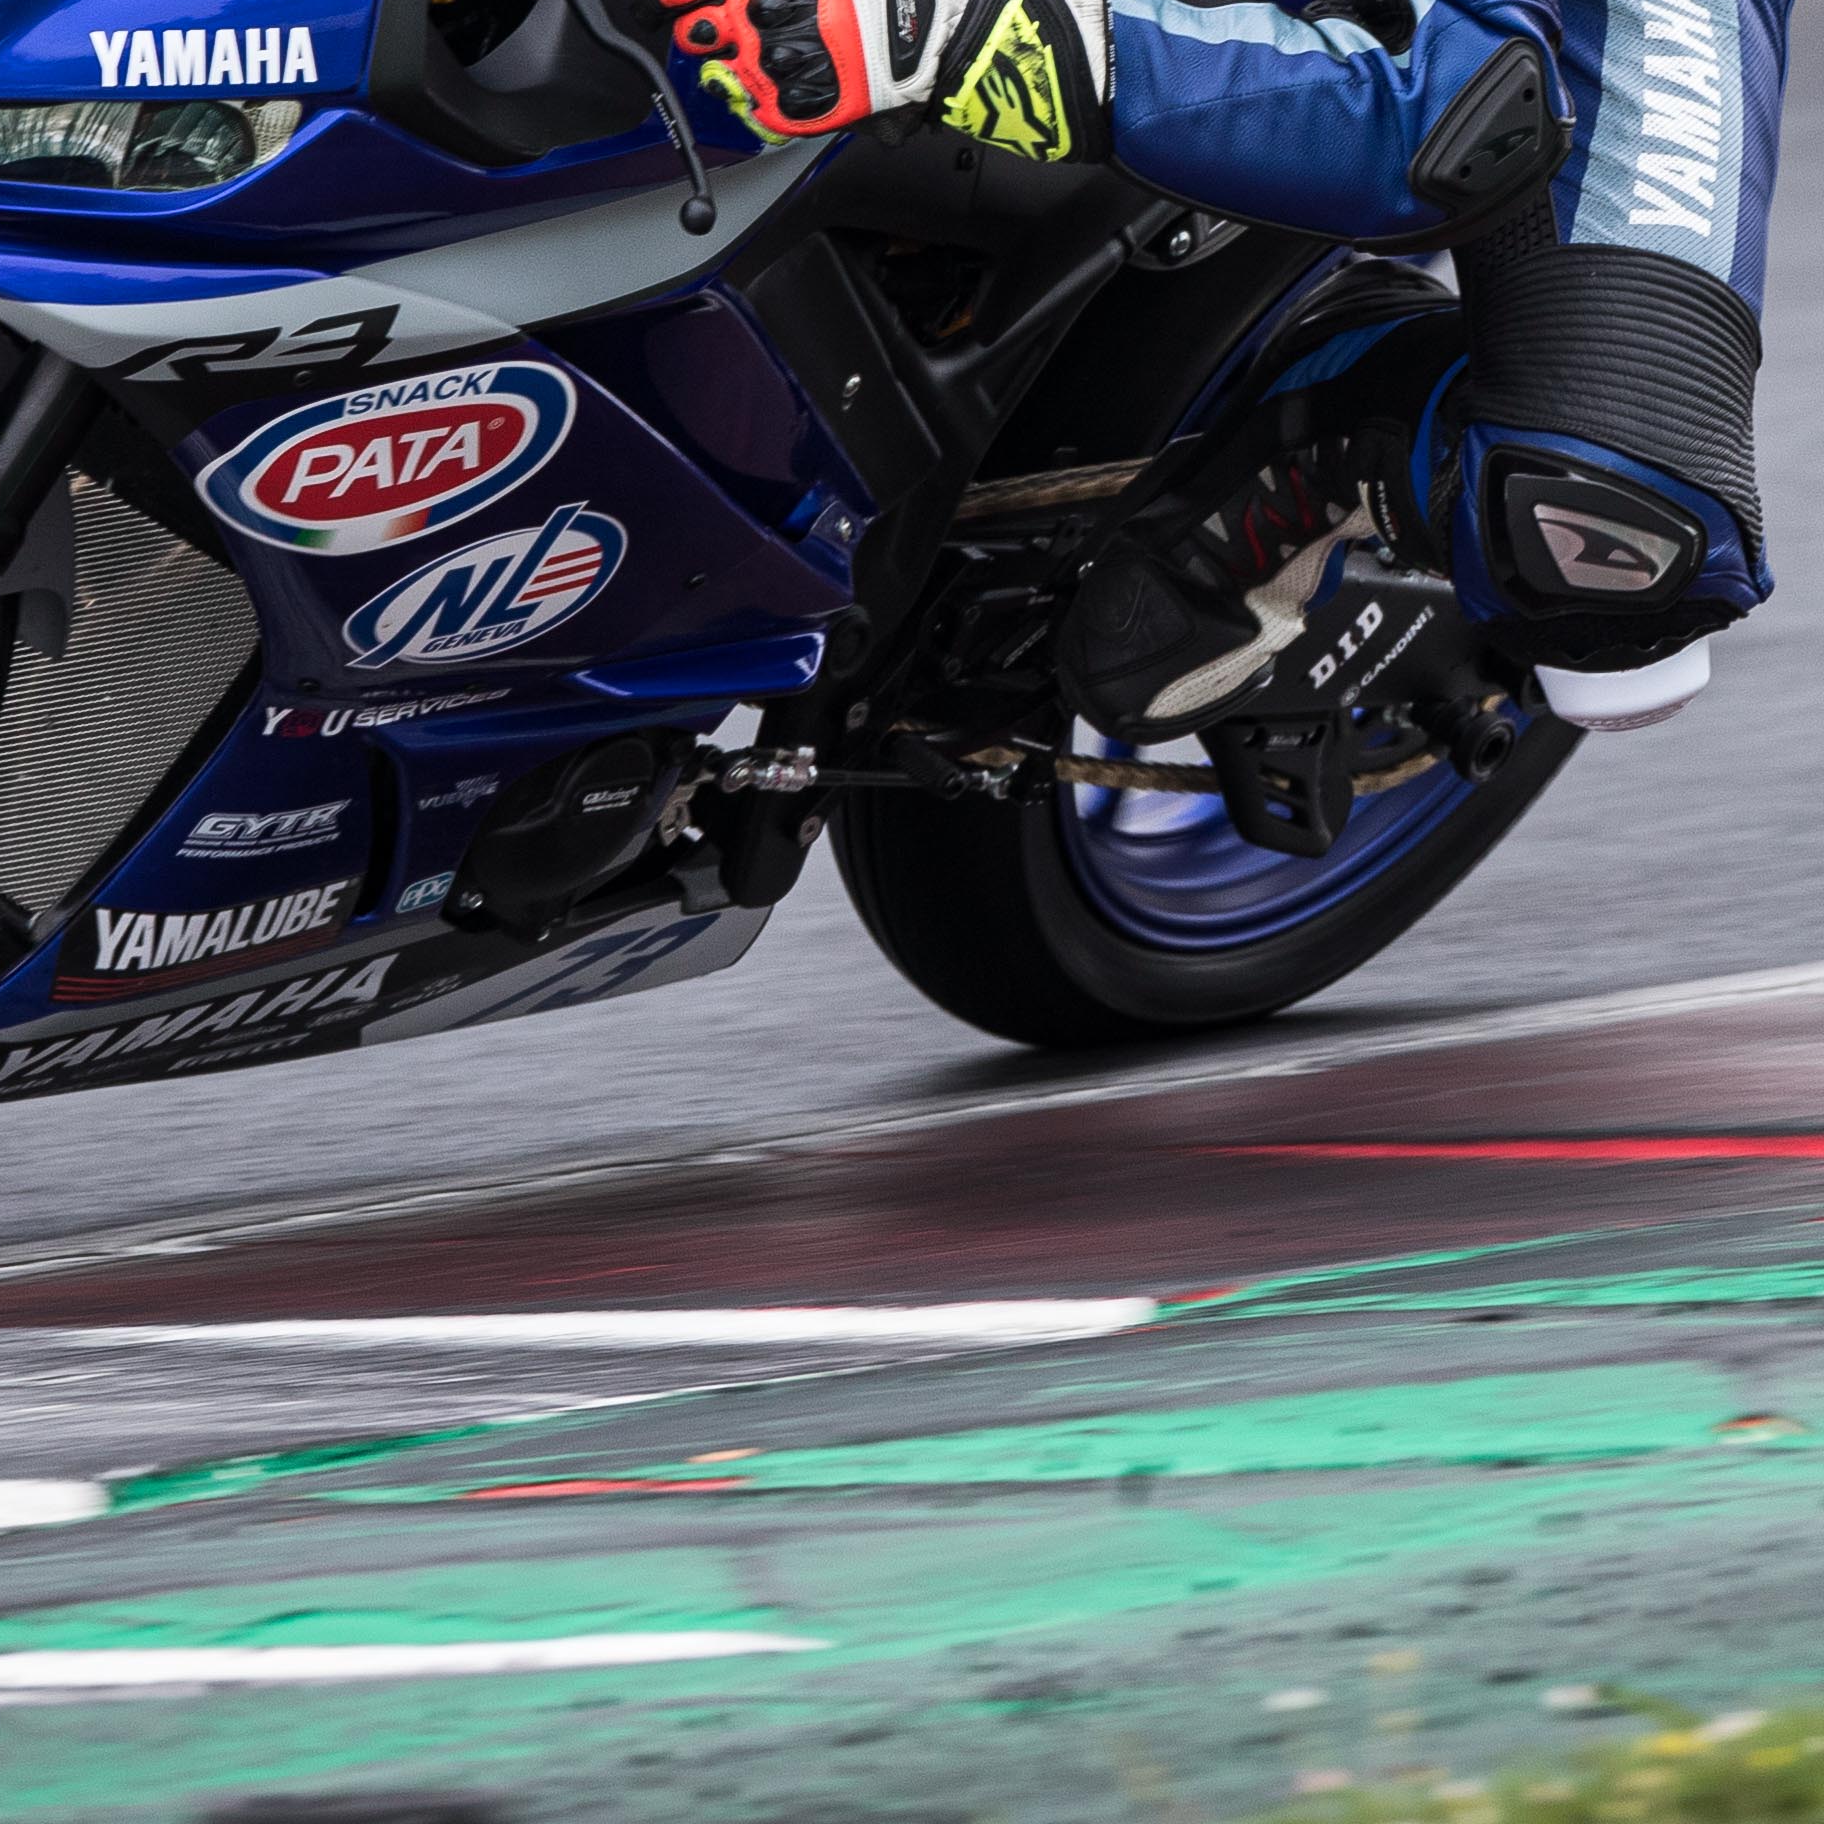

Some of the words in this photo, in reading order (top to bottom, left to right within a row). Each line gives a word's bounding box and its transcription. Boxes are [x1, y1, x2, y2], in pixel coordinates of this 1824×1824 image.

[90, 27, 318, 87] YAMAHA
[344, 371, 496, 418] SNACK
[281, 420, 483, 504] PATA
[346, 501, 589, 668] NL
[421, 620, 529, 653] GENEVA
[189, 800, 352, 839] GYTR
[94, 880, 350, 971] YAMALUBE
